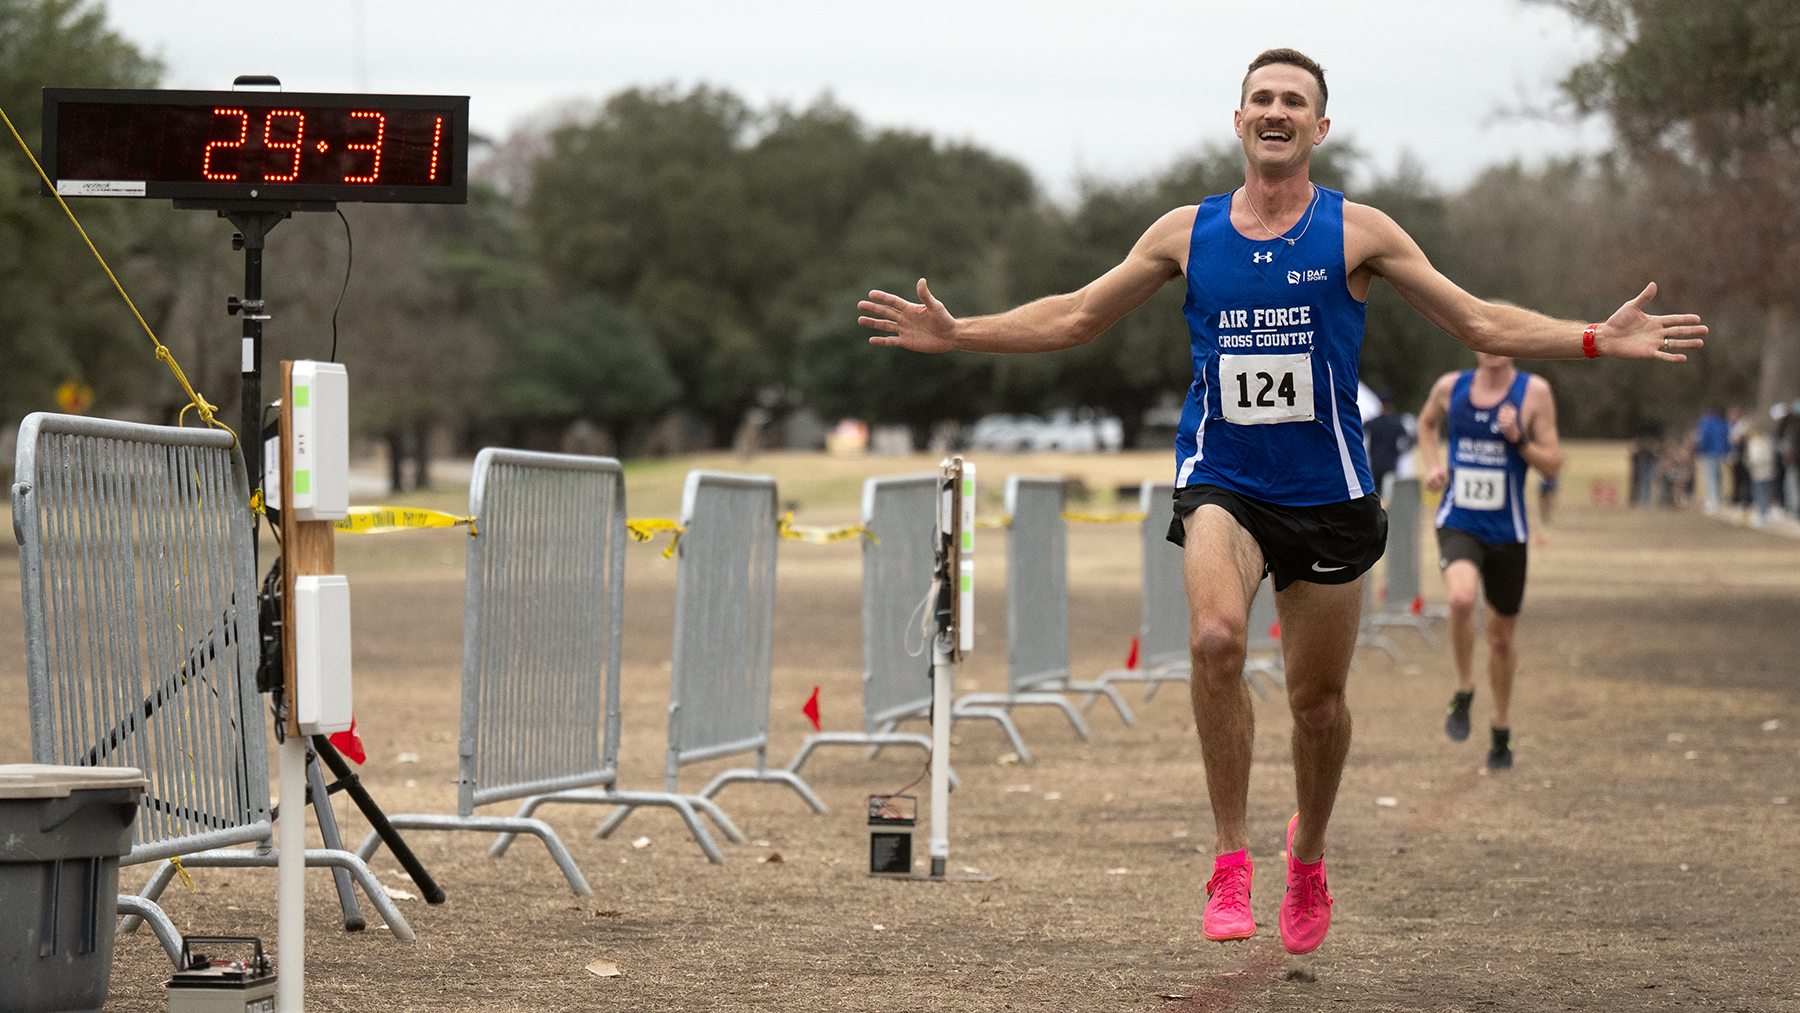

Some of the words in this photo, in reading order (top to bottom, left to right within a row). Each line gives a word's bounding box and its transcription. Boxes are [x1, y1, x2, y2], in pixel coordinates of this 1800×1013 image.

[1307, 269, 1326, 277] DAF
[1218, 310, 1248, 329] AIR
[1253, 305, 1311, 327] FORCE
[1218, 334, 1253, 348] CROSS
[1256, 331, 1314, 347] COUNTRY
[1236, 372, 1296, 407] 124
[1464, 481, 1494, 500] 123
